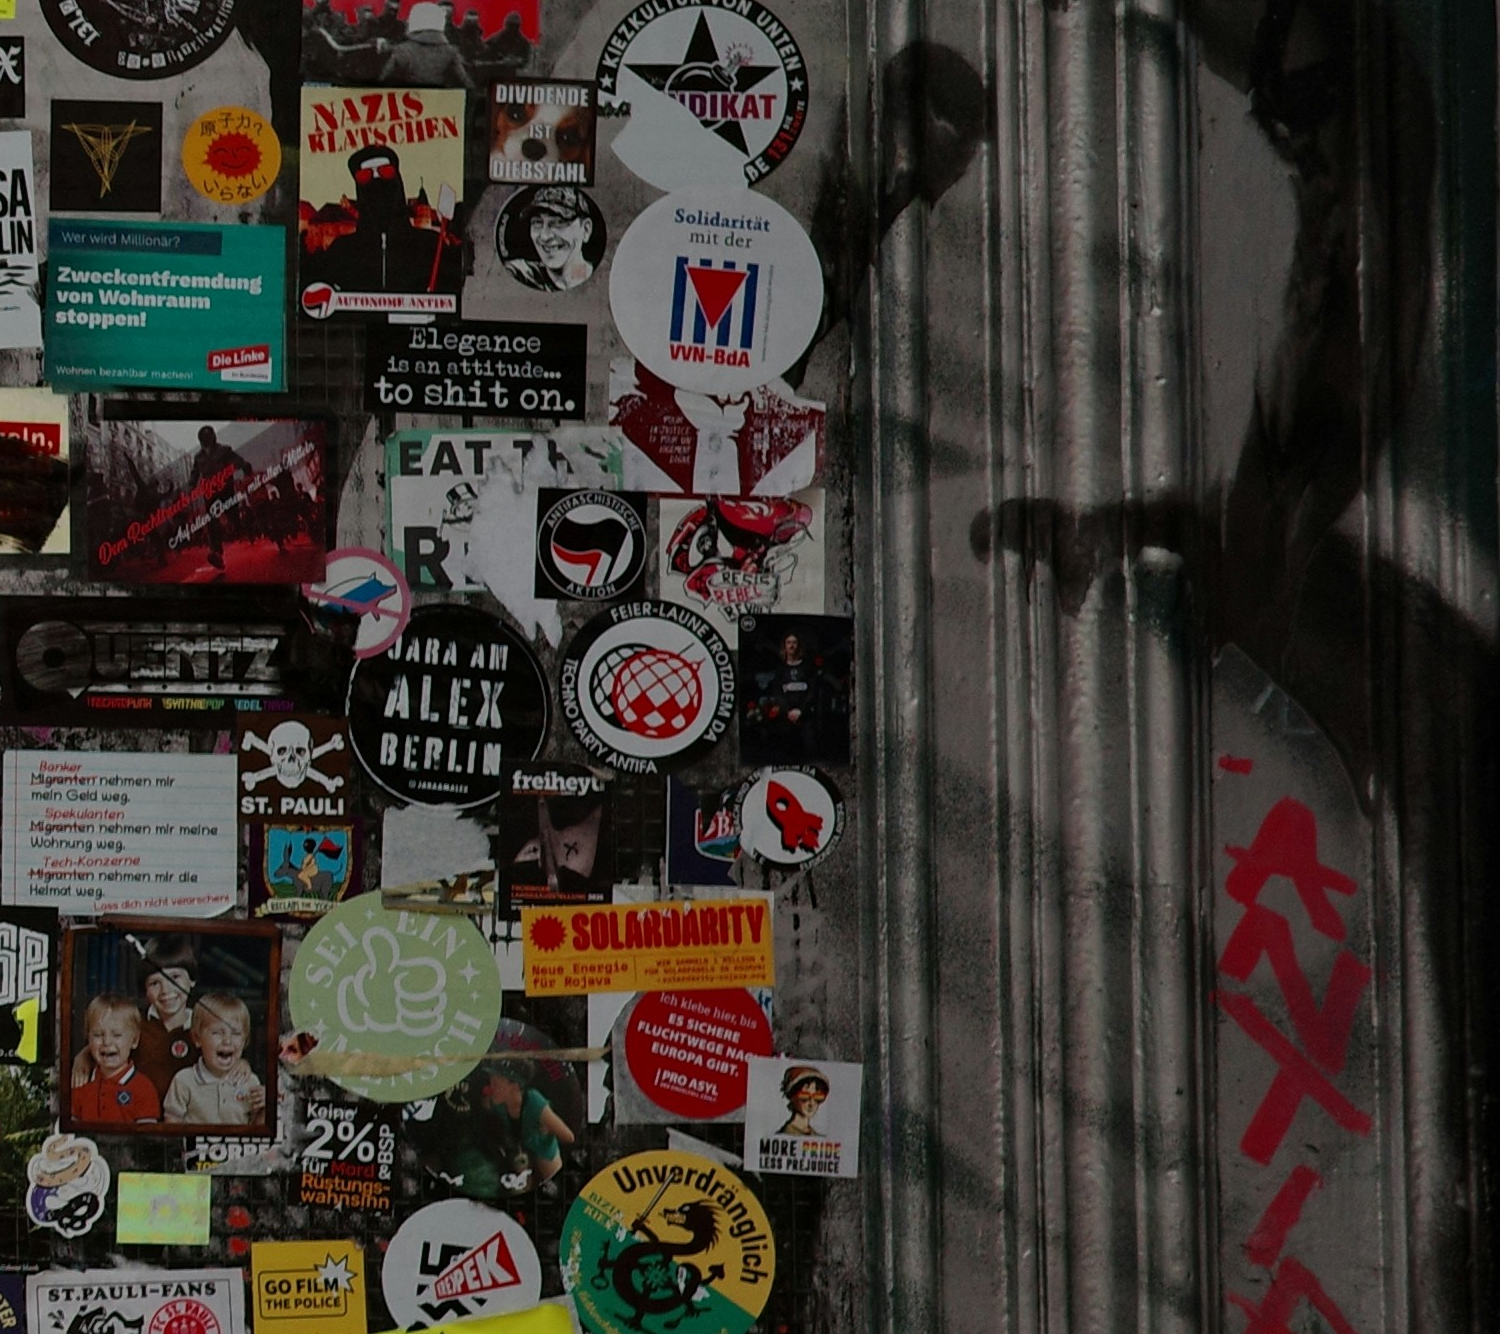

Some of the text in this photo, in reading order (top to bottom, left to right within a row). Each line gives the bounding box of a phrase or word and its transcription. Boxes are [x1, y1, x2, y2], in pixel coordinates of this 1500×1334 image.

[495, 84, 590, 107] DIVIDENDE
[313, 92, 425, 134] NAZIS
[308, 116, 459, 156] KLATSCHEN
[529, 123, 552, 140] IST
[492, 160, 588, 184] DIEBSTAHL
[675, 207, 771, 233] Solidarität
[61, 231, 181, 248] Wer wird Millionär?
[689, 229, 754, 250] mit der
[57, 266, 263, 296] Zweckentfremdung
[56, 289, 211, 311] von Wohnraum
[55, 308, 147, 330] stoppen!
[408, 327, 542, 354] Elegance
[669, 342, 751, 369] VVN-BdA
[388, 355, 563, 380] is an attitude...
[374, 376, 576, 413] to shit on.
[38, 761, 83, 773] Banker
[45, 807, 125, 822] Spekulanten
[241, 795, 345, 817] ST. PAULI
[42, 854, 141, 867] Tech-Konzerne
[571, 905, 764, 950] SOLARDARITY
[532, 962, 628, 975] Neue Energie
[533, 976, 611, 989] für Rojava
[660, 991, 757, 1030] Ich klebe hier, bis
[668, 1013, 741, 1044] ES SICHERE
[662, 1070, 687, 1084] PRO
[689, 1077, 719, 1096] ASYL
[759, 1138, 841, 1160] MORE PRIDE
[759, 1157, 841, 1174] LESS PREJUDICE
[613, 1164, 769, 1284] Unverdränglich
[264, 1276, 340, 1297] GO FILM
[265, 1297, 341, 1311] THE POLICE
